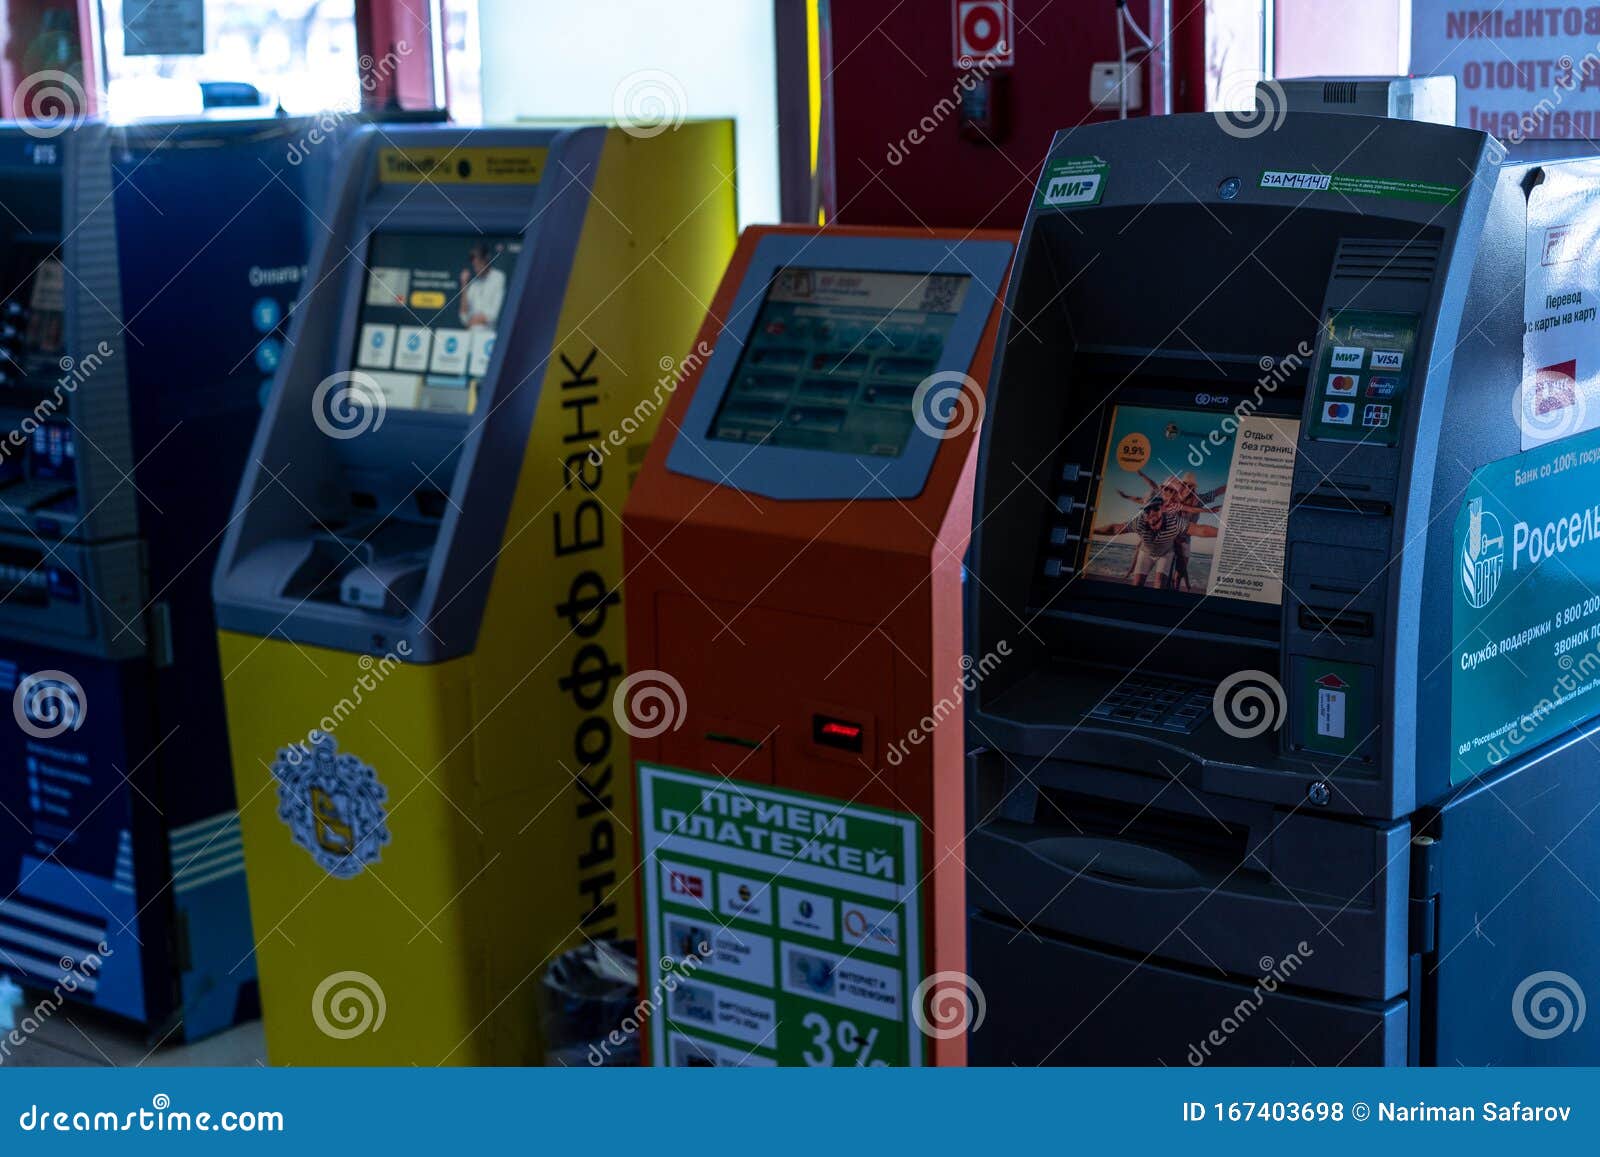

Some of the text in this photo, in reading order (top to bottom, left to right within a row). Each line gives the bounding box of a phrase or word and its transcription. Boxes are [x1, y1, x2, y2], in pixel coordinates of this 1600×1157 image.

[1050, 181, 1094, 198] МИР
[1546, 292, 1582, 309] Перевод
[1535, 316, 1560, 332] карты
[1562, 312, 1572, 325] на
[1574, 307, 1597, 323] карту
[1376, 354, 1399, 365] VISA
[1244, 430, 1273, 440] Отдых
[554, 349, 605, 557] Банк
[1241, 442, 1293, 455] без границ
[1515, 467, 1538, 487] Банк
[1540, 463, 1551, 478] со
[1553, 451, 1578, 474] 100%
[1461, 594, 1600, 671] Служба поддержки 8 800 200
[1554, 628, 1589, 656] звонок
[701, 789, 847, 841] ПРИЕМ
[660, 807, 896, 879] ПЛАТЕЖЕЙ
